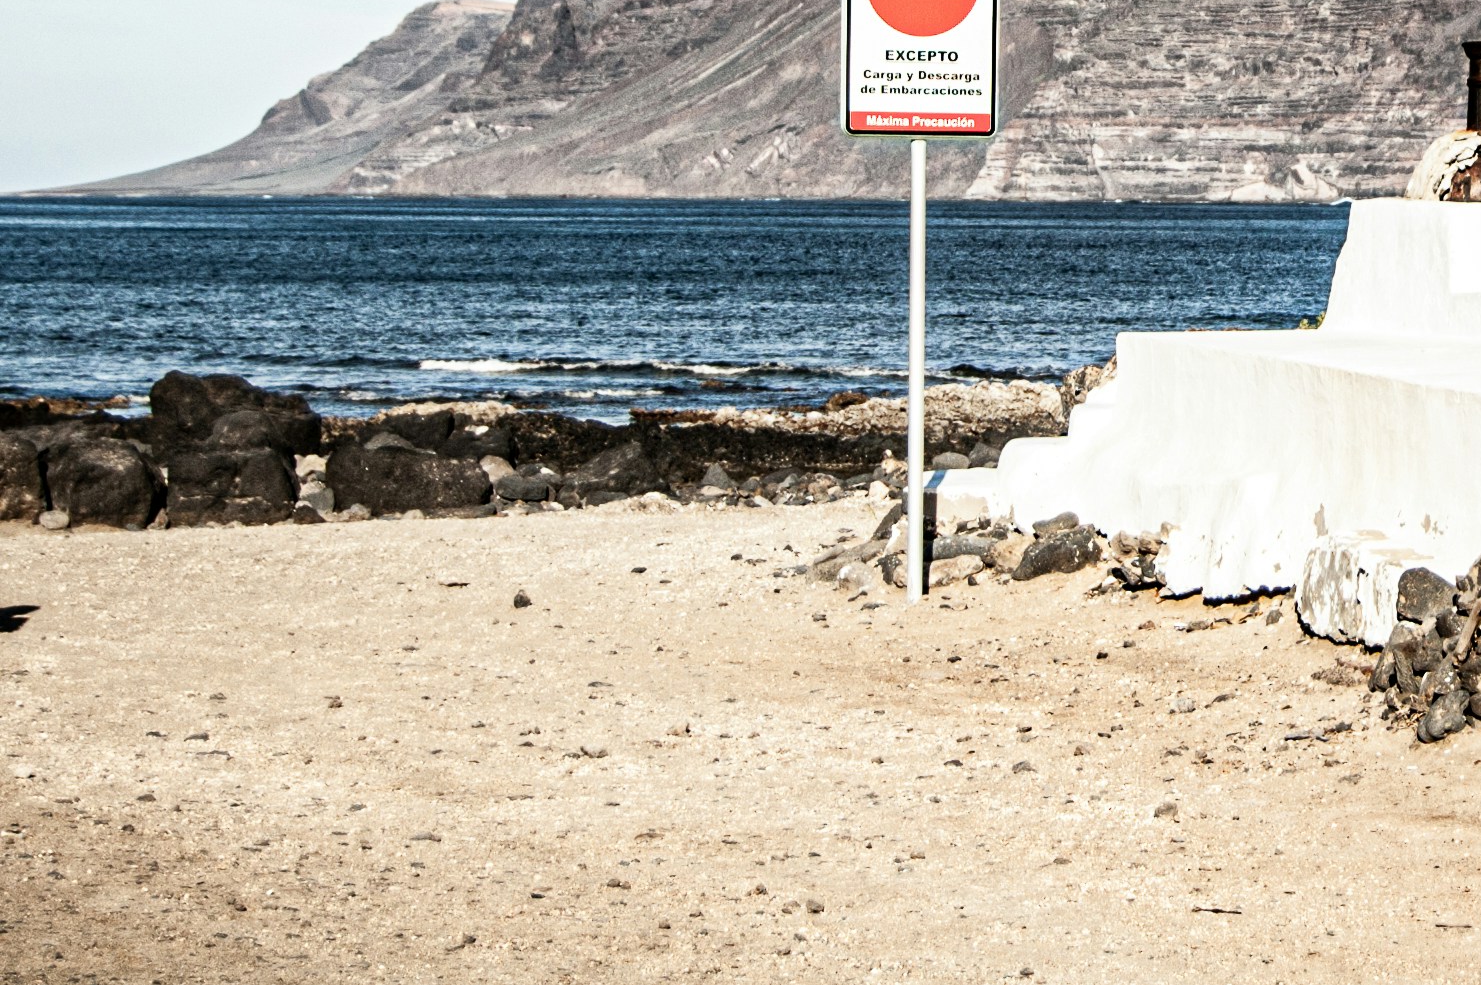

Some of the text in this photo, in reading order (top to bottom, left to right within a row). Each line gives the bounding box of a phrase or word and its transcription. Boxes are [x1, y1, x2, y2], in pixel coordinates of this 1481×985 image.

[885, 49, 959, 62] EXCEPTO
[863, 69, 980, 83] Carga y Descarga
[860, 84, 983, 96] de Embarcaciones
[866, 114, 975, 128] Máxima Precaución
